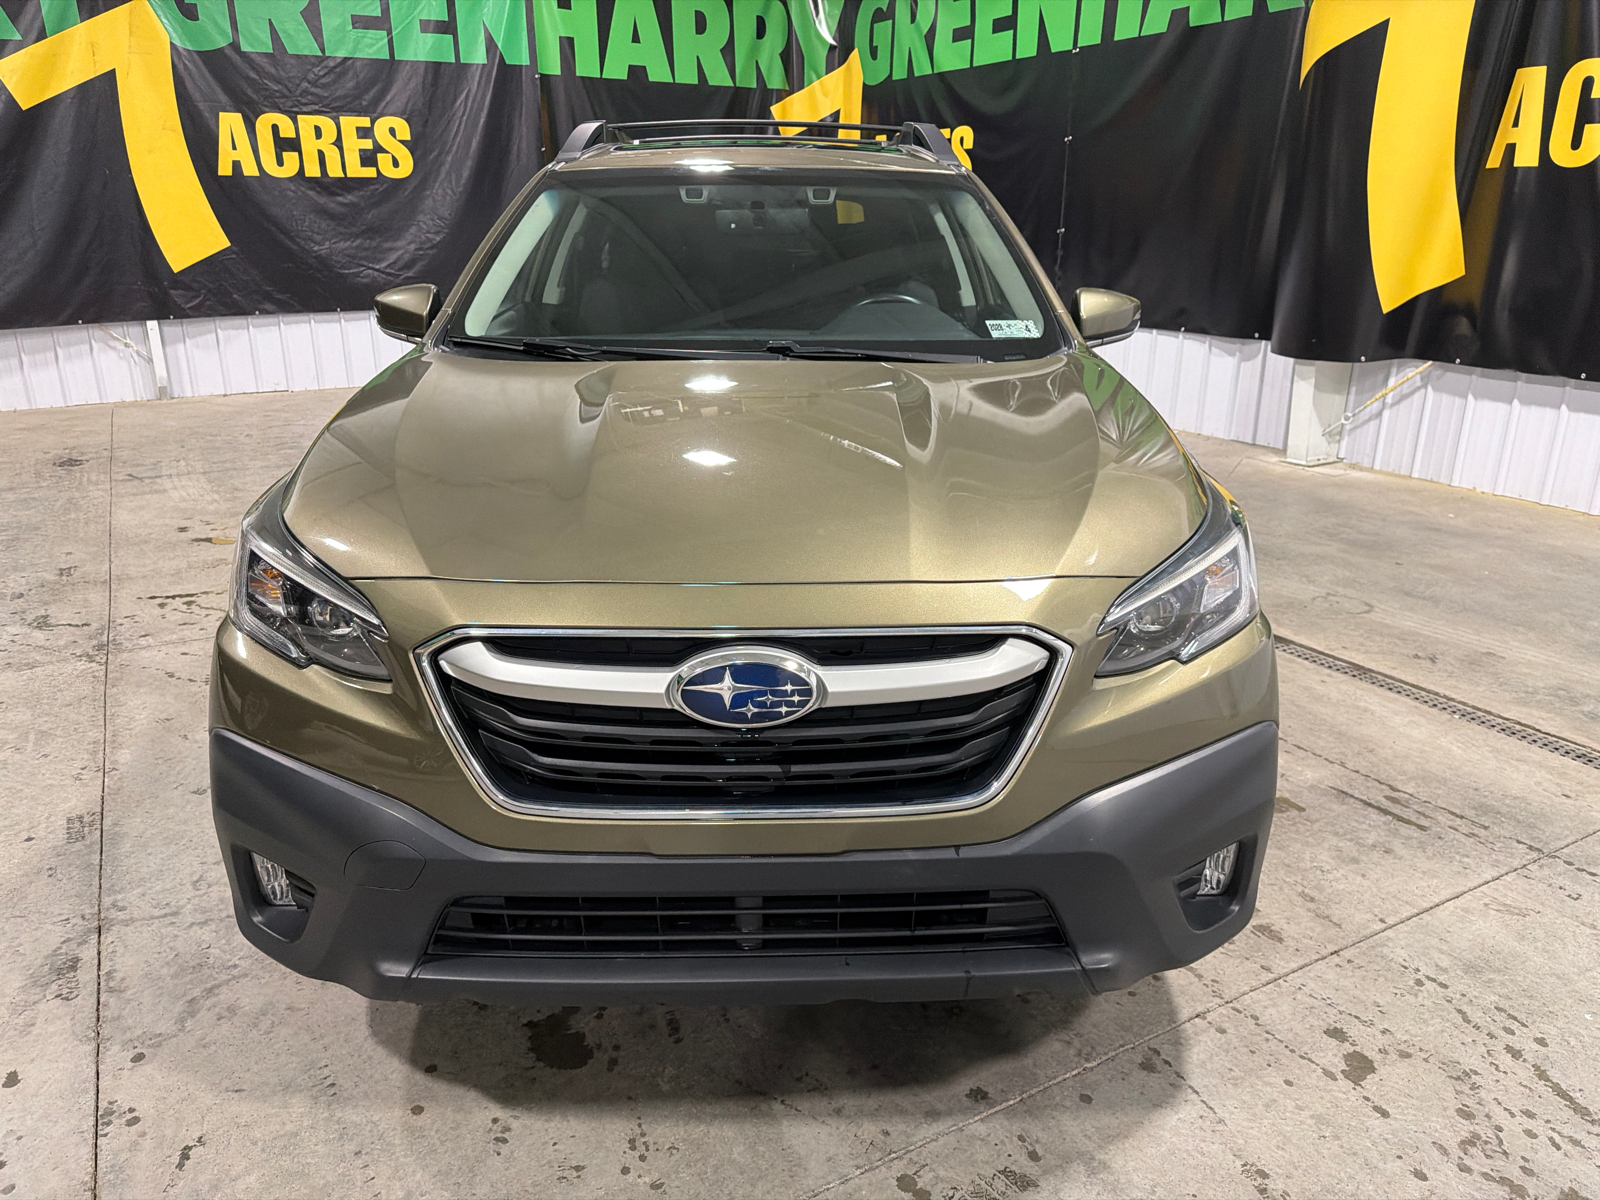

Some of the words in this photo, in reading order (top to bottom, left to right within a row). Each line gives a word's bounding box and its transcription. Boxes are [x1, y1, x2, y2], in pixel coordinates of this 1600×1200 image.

[0, 0, 231, 273] 7
[218, 112, 414, 179] ACRES
[534, 0, 837, 90] HARRY
[855, 0, 1075, 86] GREEN
[1300, 0, 1474, 314] 7
[1486, 57, 1600, 168] AC
